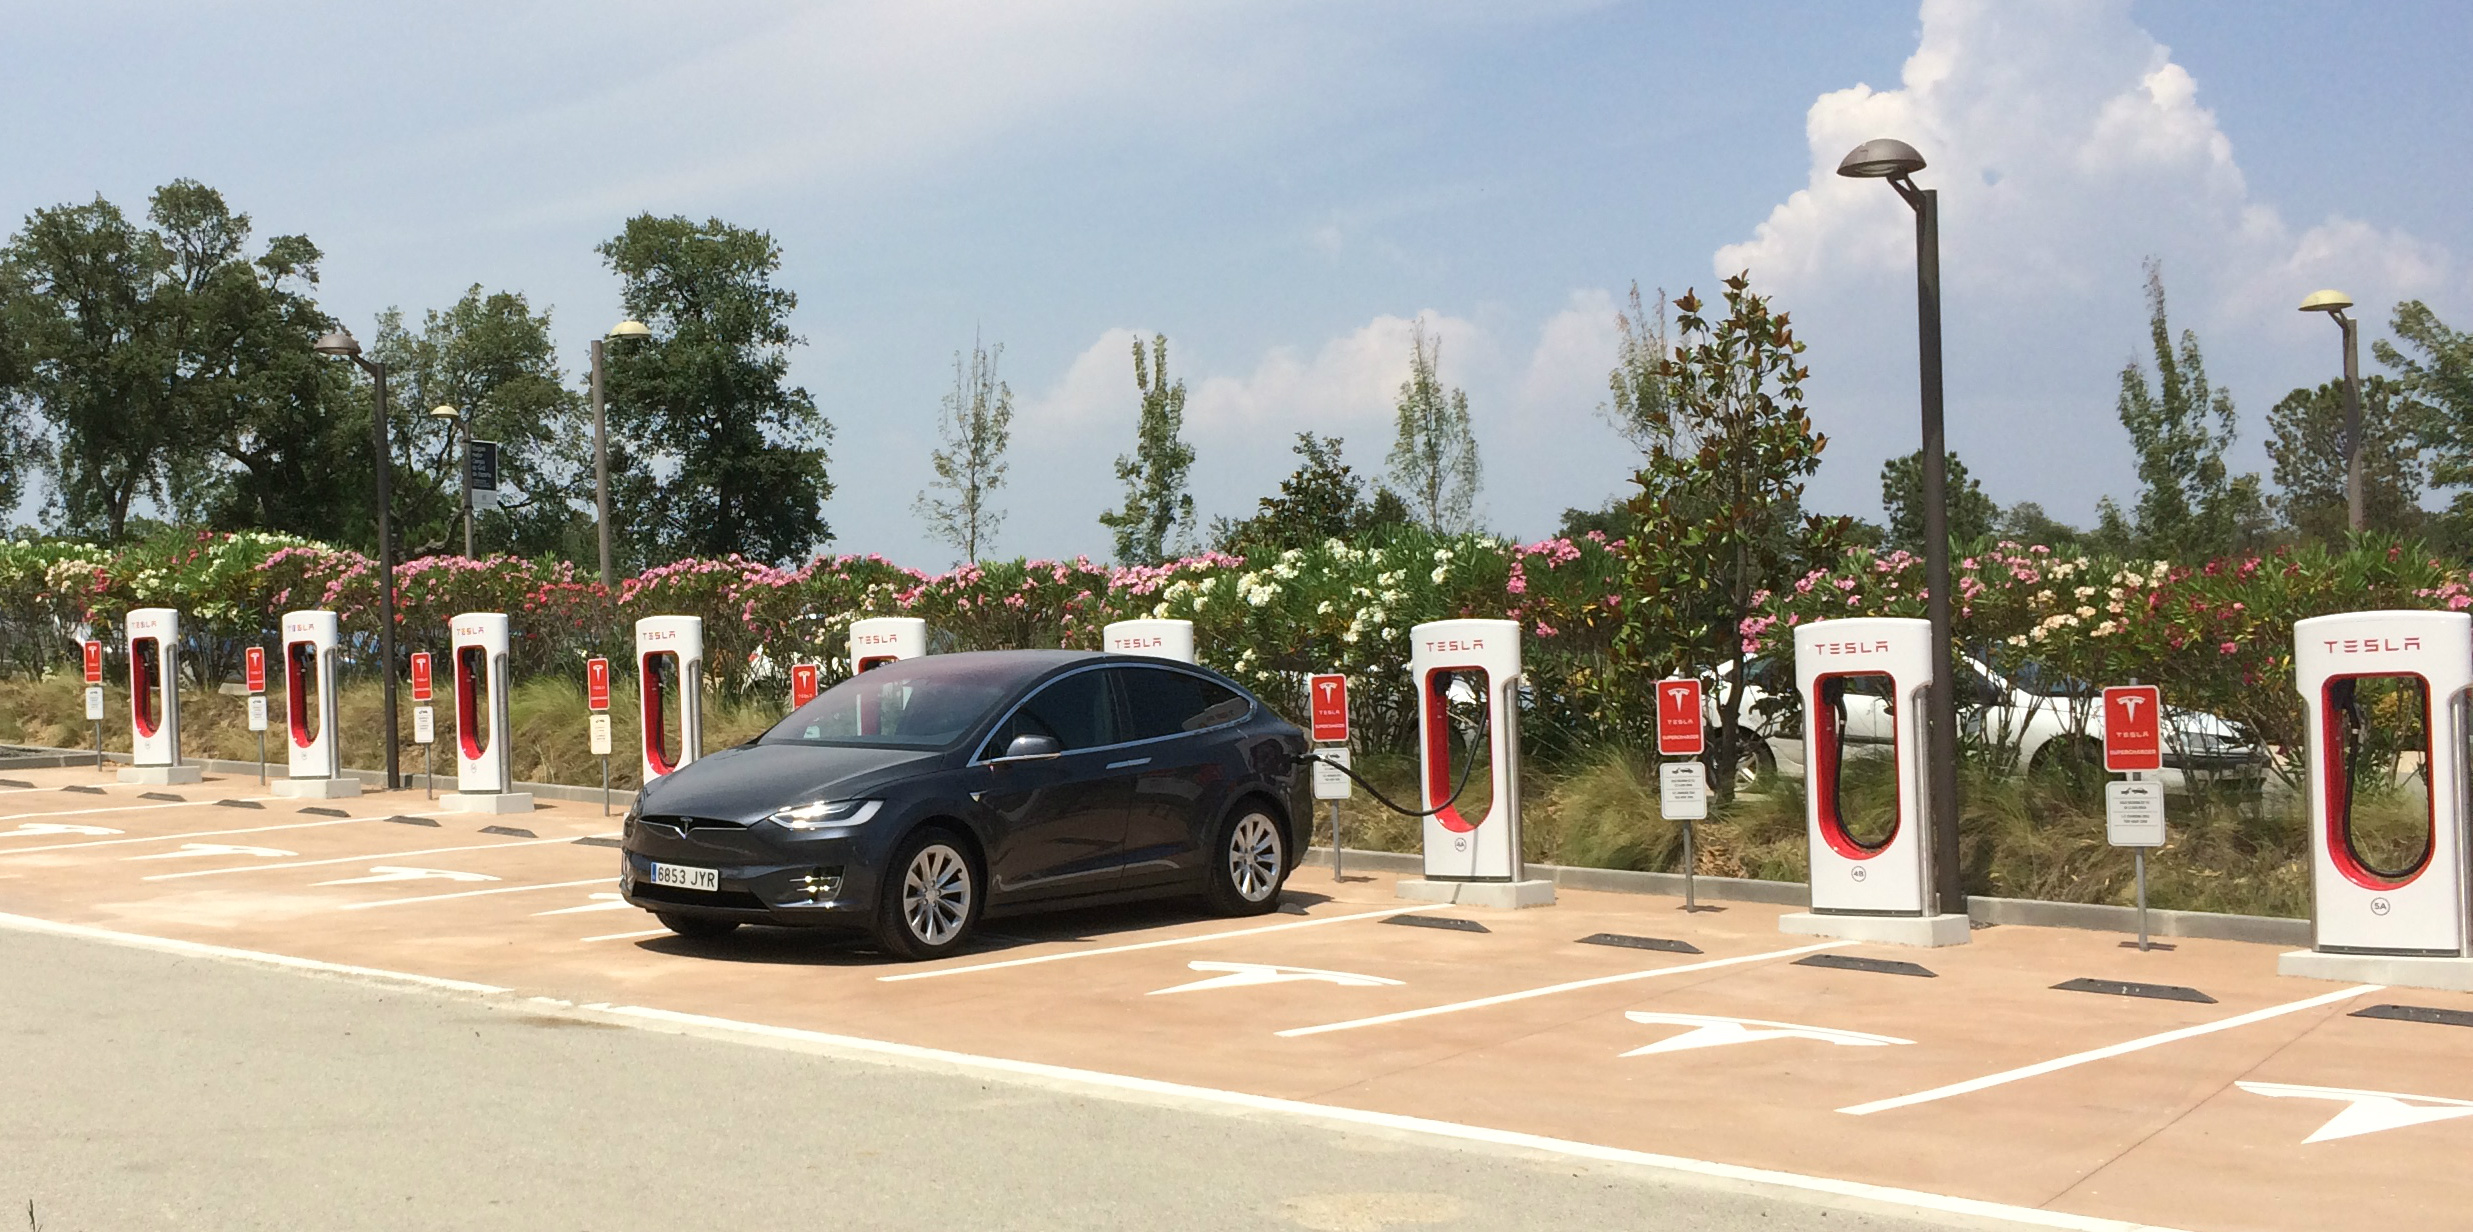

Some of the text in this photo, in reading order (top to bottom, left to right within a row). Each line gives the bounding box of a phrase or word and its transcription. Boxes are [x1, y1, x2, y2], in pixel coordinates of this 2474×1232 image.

[456, 626, 484, 636] TESLA
[642, 630, 676, 640] TESLA
[858, 634, 898, 645] TESLA
[1114, 637, 1162, 649] TESLA
[1426, 639, 1484, 652] TESLA
[1814, 640, 1888, 655] TESLA
[2323, 637, 2421, 654] TESLA
[2115, 730, 2149, 738] TESLA
[658, 866, 715, 888] 6853 JYR
[2374, 902, 2387, 910] 5A
